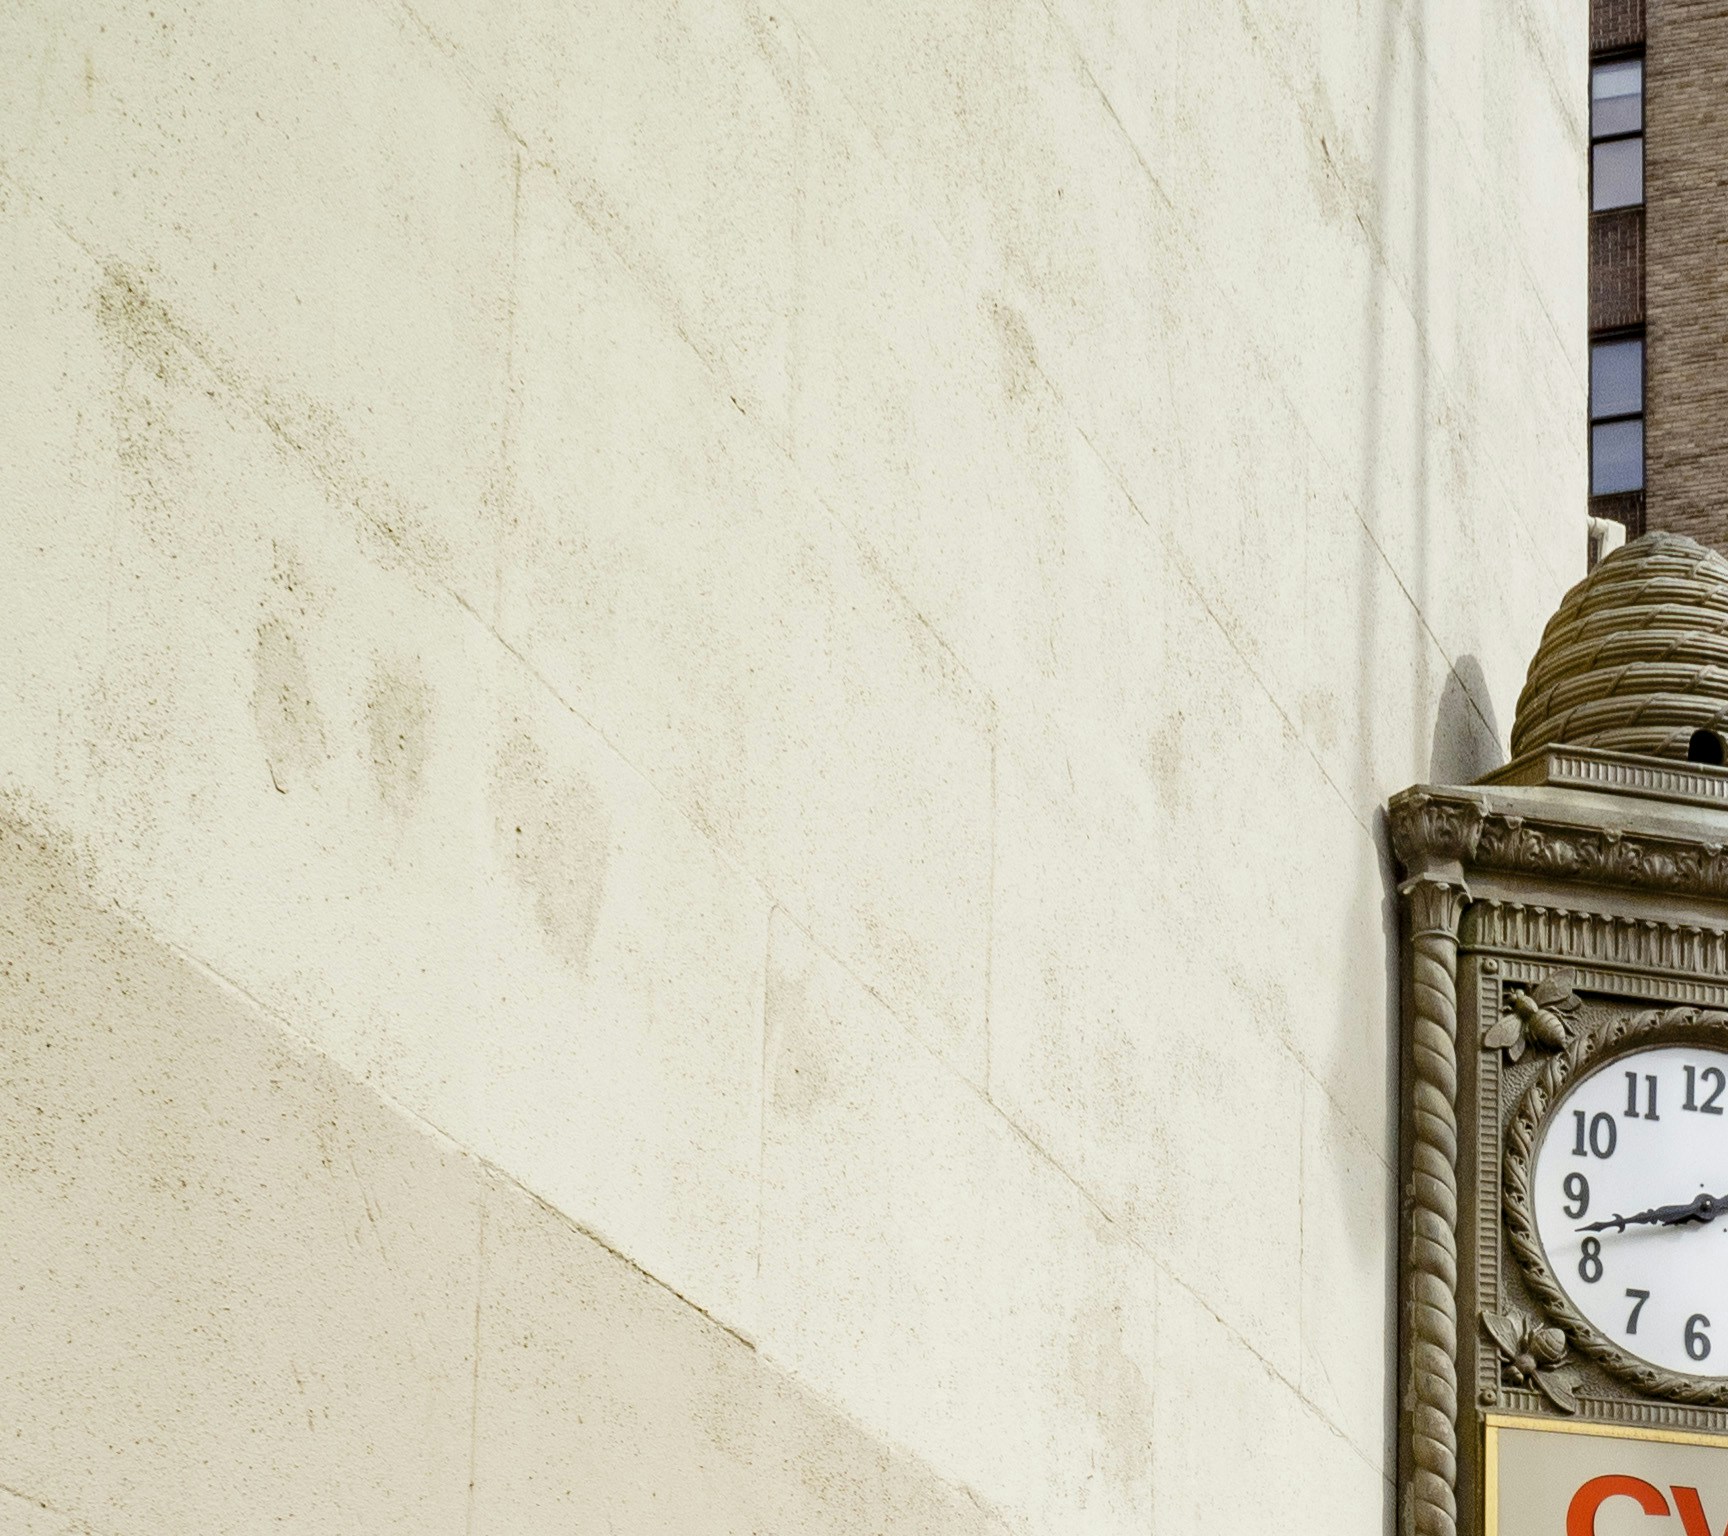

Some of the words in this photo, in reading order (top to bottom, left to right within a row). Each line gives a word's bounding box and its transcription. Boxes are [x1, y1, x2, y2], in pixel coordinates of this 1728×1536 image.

[1624, 1072, 1659, 1121] 11
[1682, 1066, 1723, 1114] 12
[1572, 1112, 1616, 1159] 10
[1563, 1172, 1589, 1218] 9
[1578, 1237, 1602, 1282] 8
[1625, 1289, 1650, 1334] 7
[1684, 1313, 1710, 1360] 6
